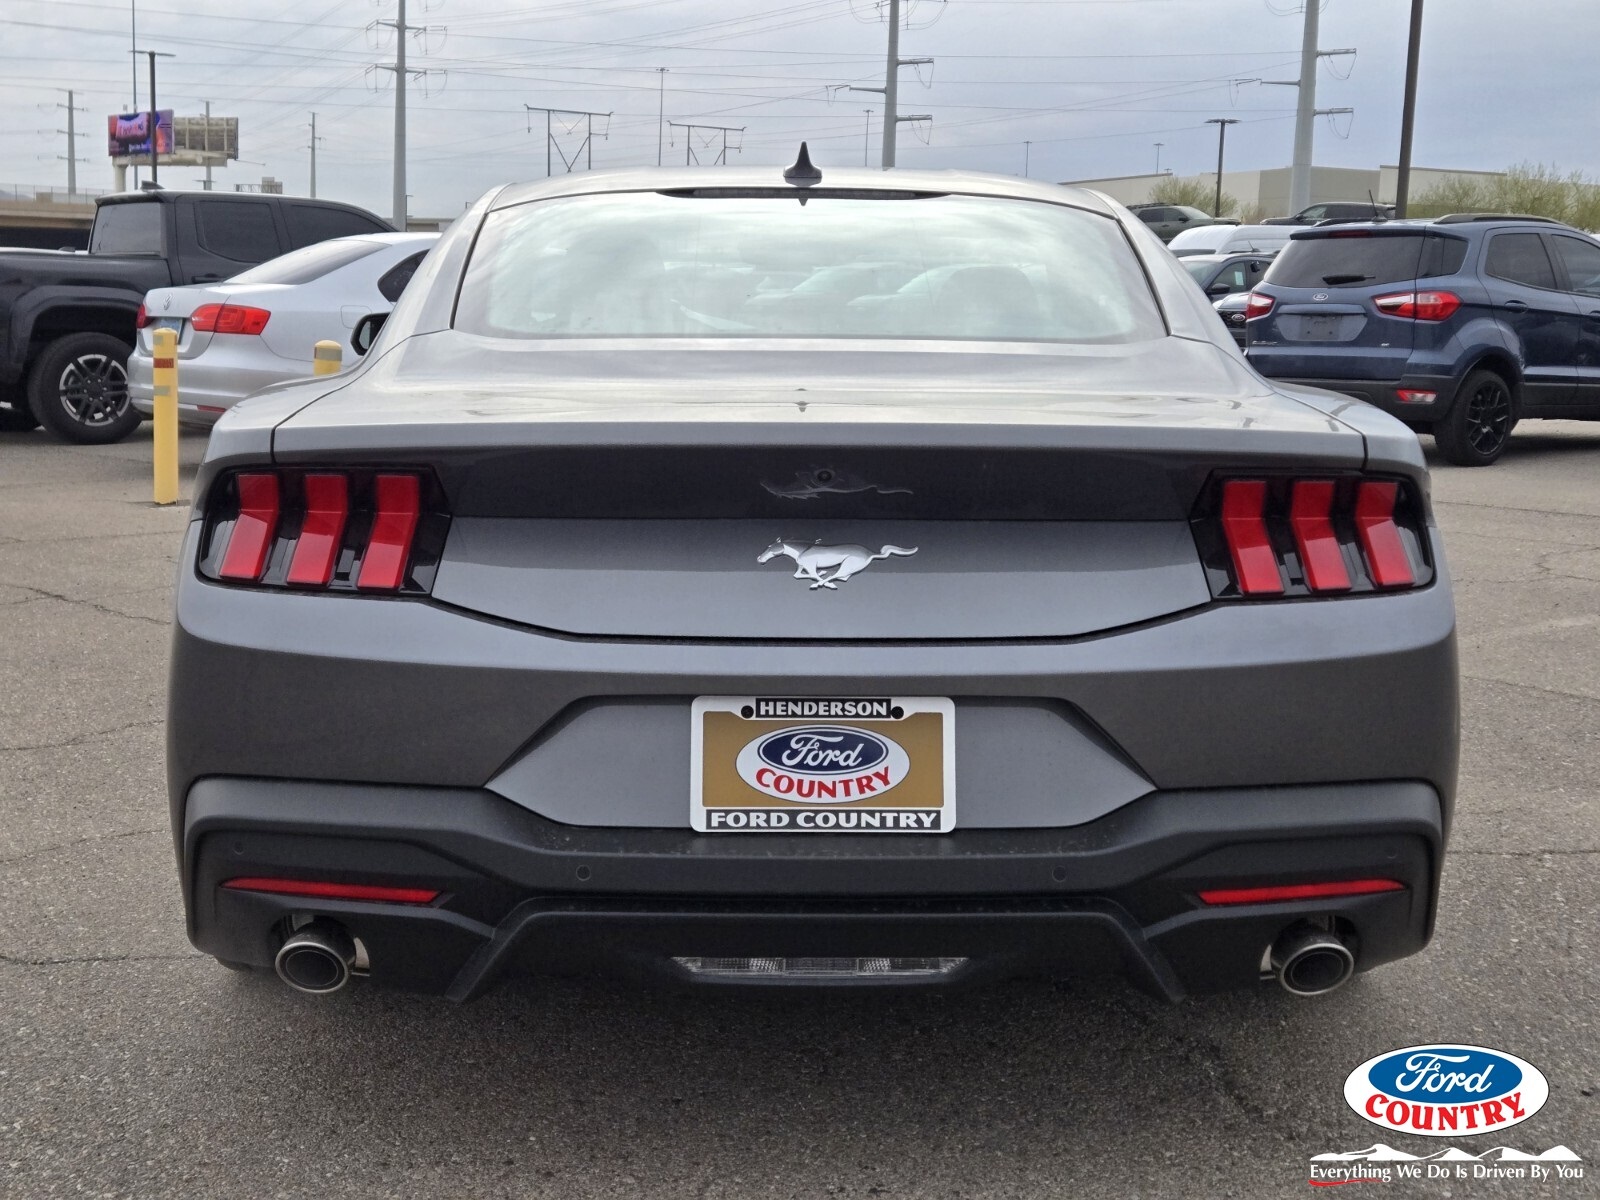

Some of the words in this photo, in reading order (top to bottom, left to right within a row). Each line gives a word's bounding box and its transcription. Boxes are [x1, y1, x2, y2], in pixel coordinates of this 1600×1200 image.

[759, 701, 888, 716] HENDERSON
[781, 733, 865, 767] Ford
[755, 765, 891, 799] COUNTRY
[710, 812, 790, 828] FORD
[796, 811, 938, 828] COUNTRY
